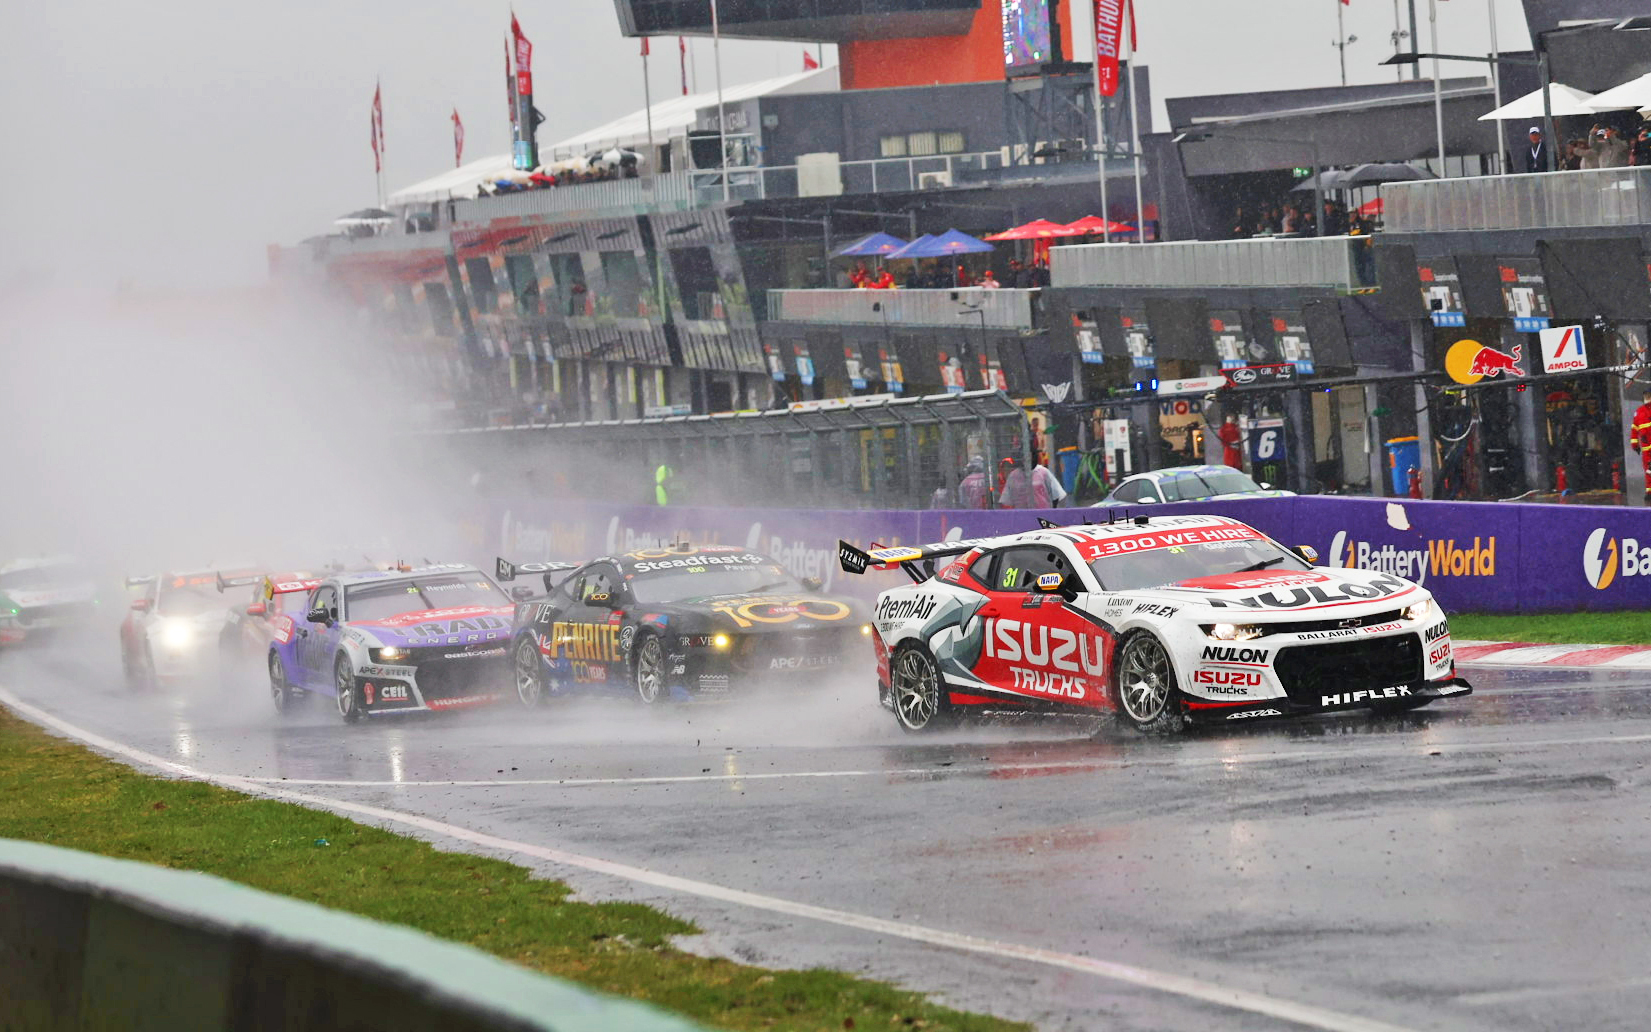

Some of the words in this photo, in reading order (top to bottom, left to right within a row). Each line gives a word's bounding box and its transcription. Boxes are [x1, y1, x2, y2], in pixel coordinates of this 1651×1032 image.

[1097, 0, 1119, 57] BATHU
[1260, 366, 1291, 375] GROVE
[1547, 360, 1585, 371] AMPOL
[1258, 431, 1277, 459] 6
[1090, 537, 1156, 557] 1300
[1159, 532, 1202, 545] WE
[1203, 528, 1256, 542] HIRE
[1169, 546, 1186, 554] 31
[839, 548, 866, 567] SYZMIK
[874, 548, 918, 559] NAPA
[520, 561, 582, 572] GR
[634, 554, 744, 573] Steadfast
[687, 566, 706, 574] 100
[1003, 567, 1018, 588] 31
[1040, 575, 1059, 585] NAPA
[425, 583, 467, 592] Reynolds
[1206, 573, 1405, 608] NULON
[878, 593, 938, 620] PremiAir
[1107, 597, 1134, 607] Luxton
[1132, 603, 1180, 619] HIFLEX
[1297, 629, 1358, 641] BALLARAT
[1363, 623, 1402, 633] ISUZU
[551, 621, 623, 662] PENRITE
[985, 617, 1104, 677] ISUZU
[1202, 645, 1269, 663] NULON
[359, 666, 386, 677] APEX
[1194, 671, 1261, 686] ISUZU
[1009, 666, 1087, 699] TRUCKS
[1205, 686, 1248, 695] TRUCKS
[381, 686, 408, 698] CEIL
[1321, 685, 1413, 707] HIFLEX
